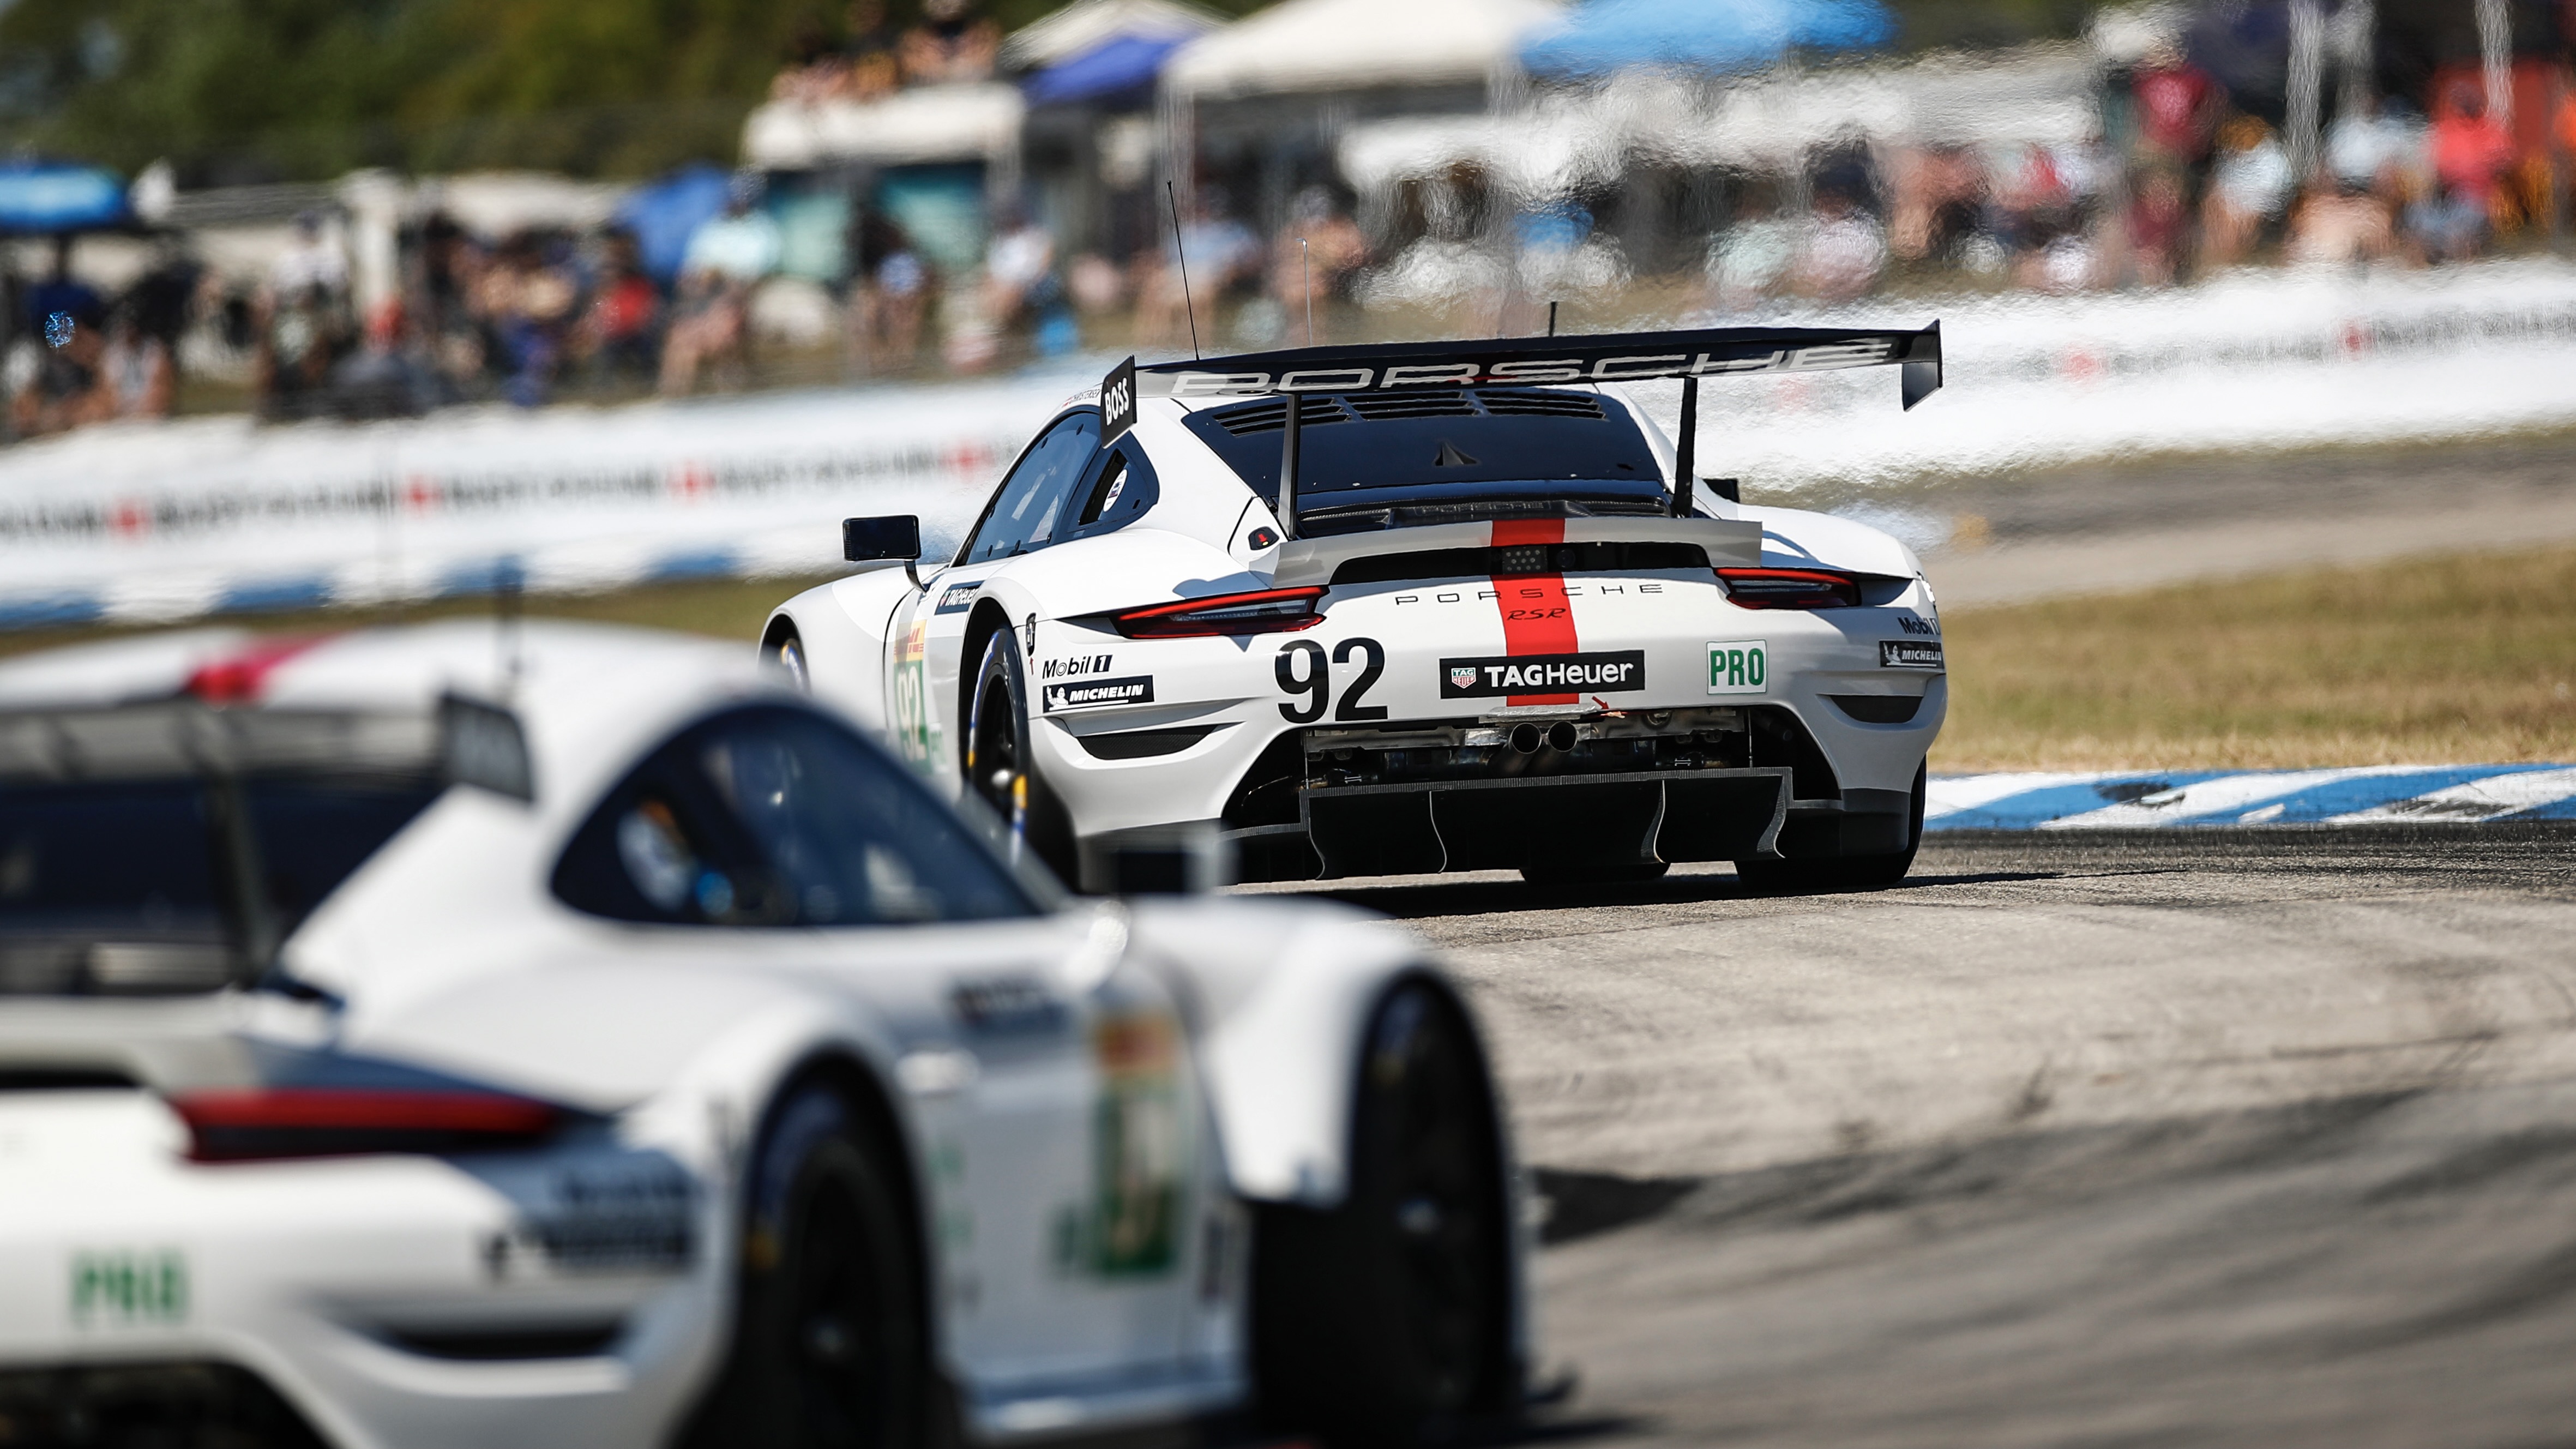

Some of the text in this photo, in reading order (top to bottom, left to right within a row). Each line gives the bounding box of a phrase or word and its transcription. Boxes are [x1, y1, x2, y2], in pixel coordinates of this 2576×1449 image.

[1171, 343, 1892, 394] PORSCHE
[1105, 377, 1129, 426] BOSS
[1395, 584, 1663, 605] PORSCHE
[1507, 608, 1566, 621] RSR
[1042, 656, 1091, 680] Mobil
[1274, 637, 1388, 724] 92
[1710, 648, 1765, 686] PRO
[1069, 684, 1144, 702] MICHELIN
